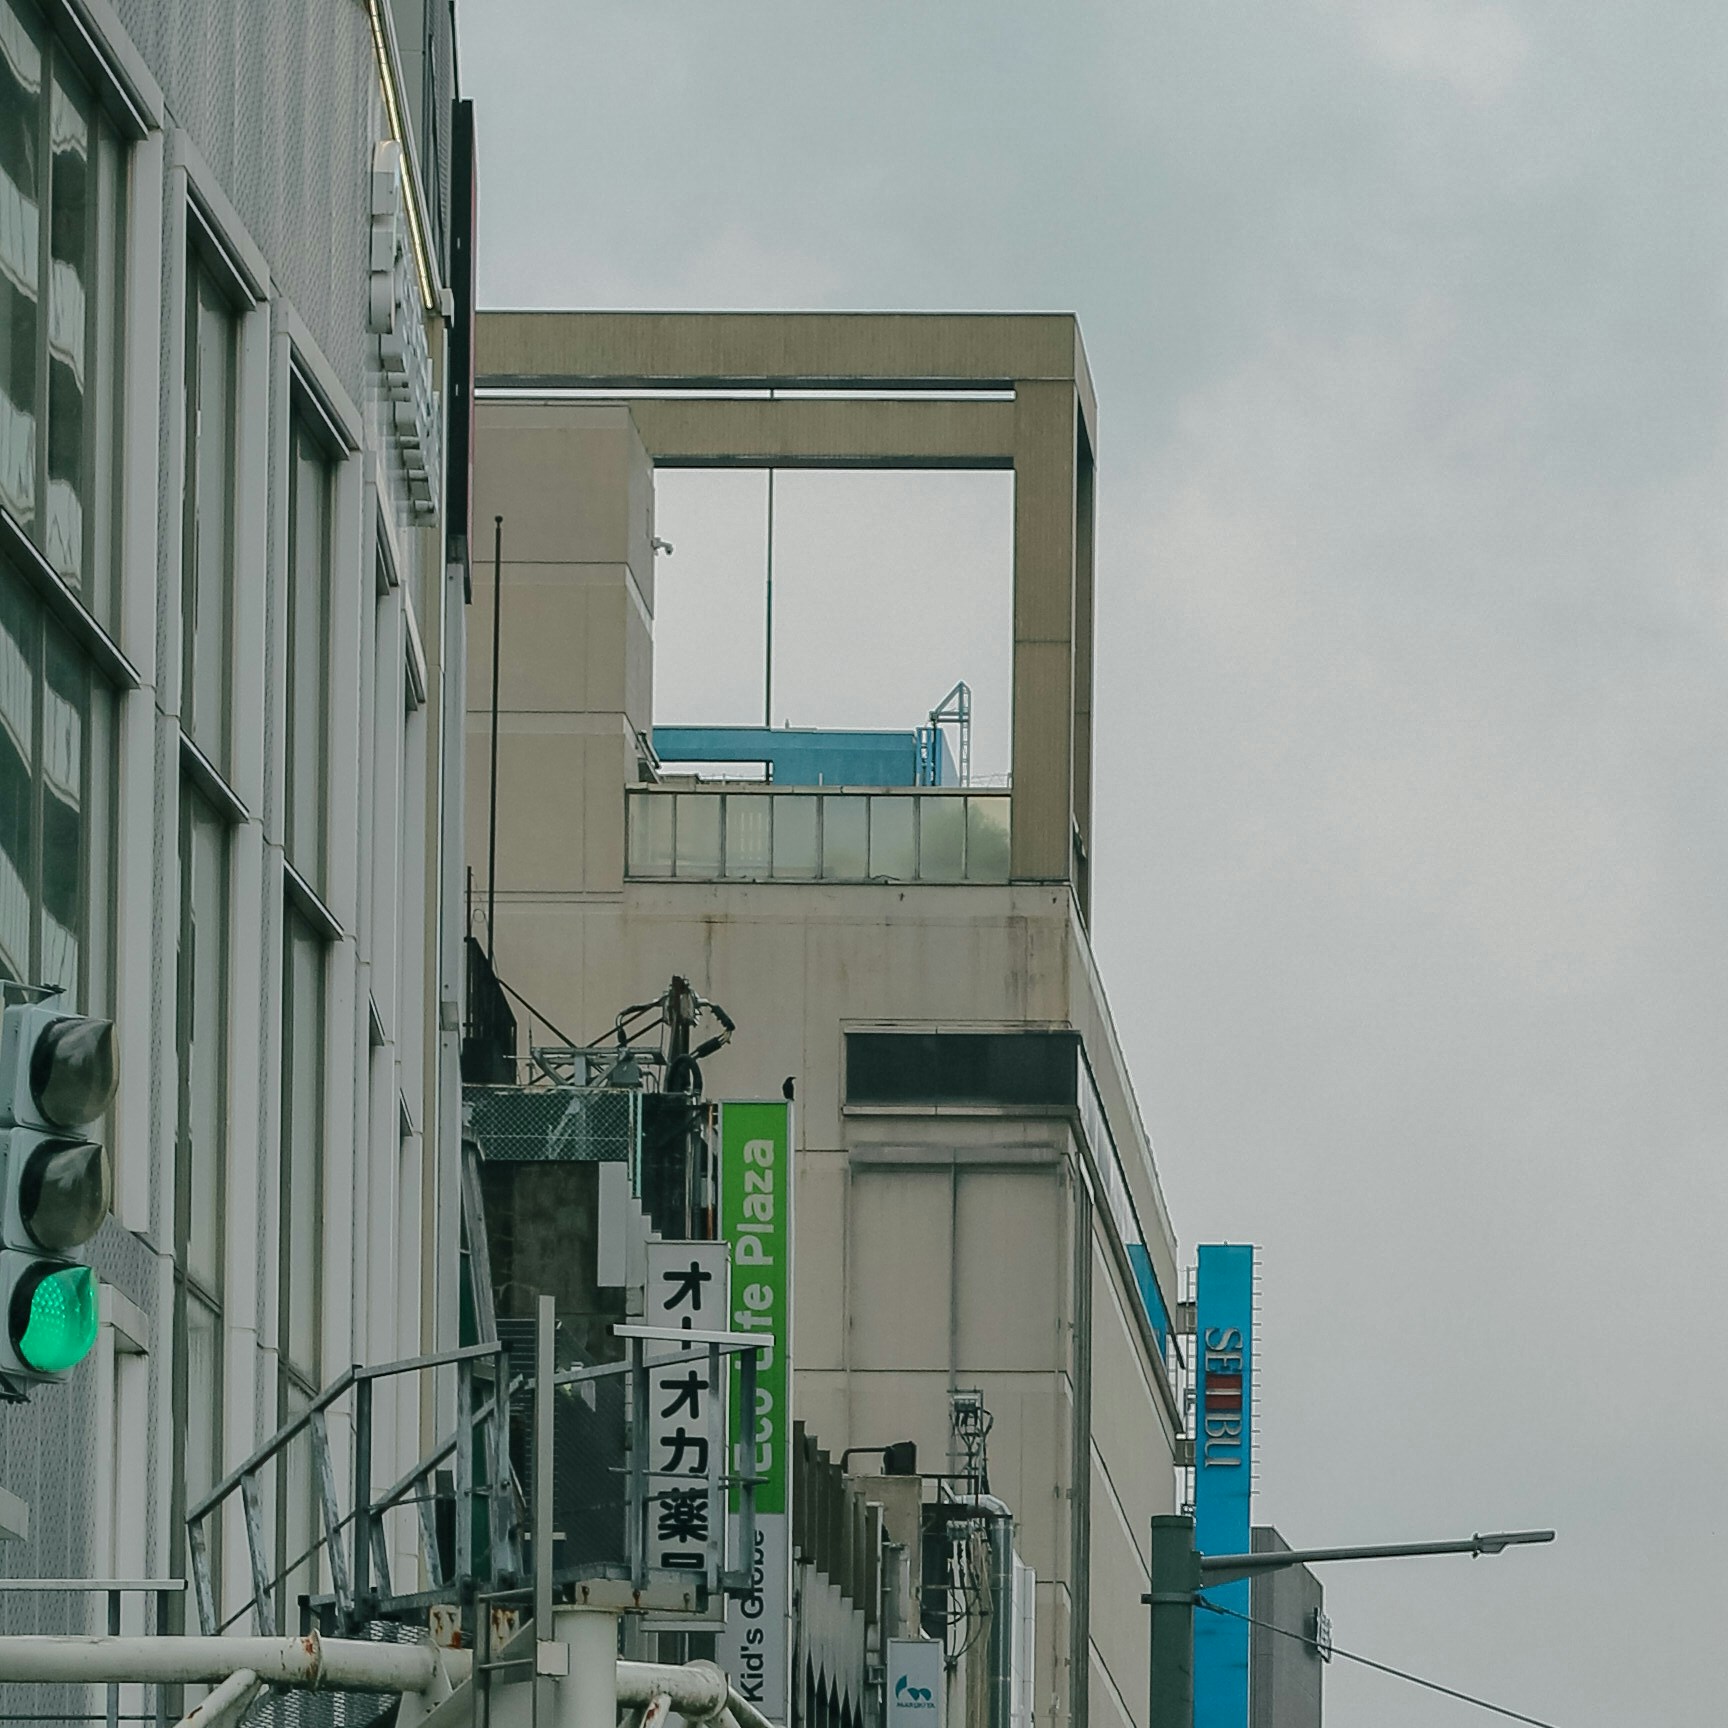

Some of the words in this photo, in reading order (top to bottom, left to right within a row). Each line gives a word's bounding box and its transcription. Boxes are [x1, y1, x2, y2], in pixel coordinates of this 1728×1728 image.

[734, 1139, 774, 1265] Plaza
[734, 1284, 774, 1371] Lfe
[1204, 1327, 1243, 1468] SEIBU
[740, 1628, 764, 1702] Kid's
